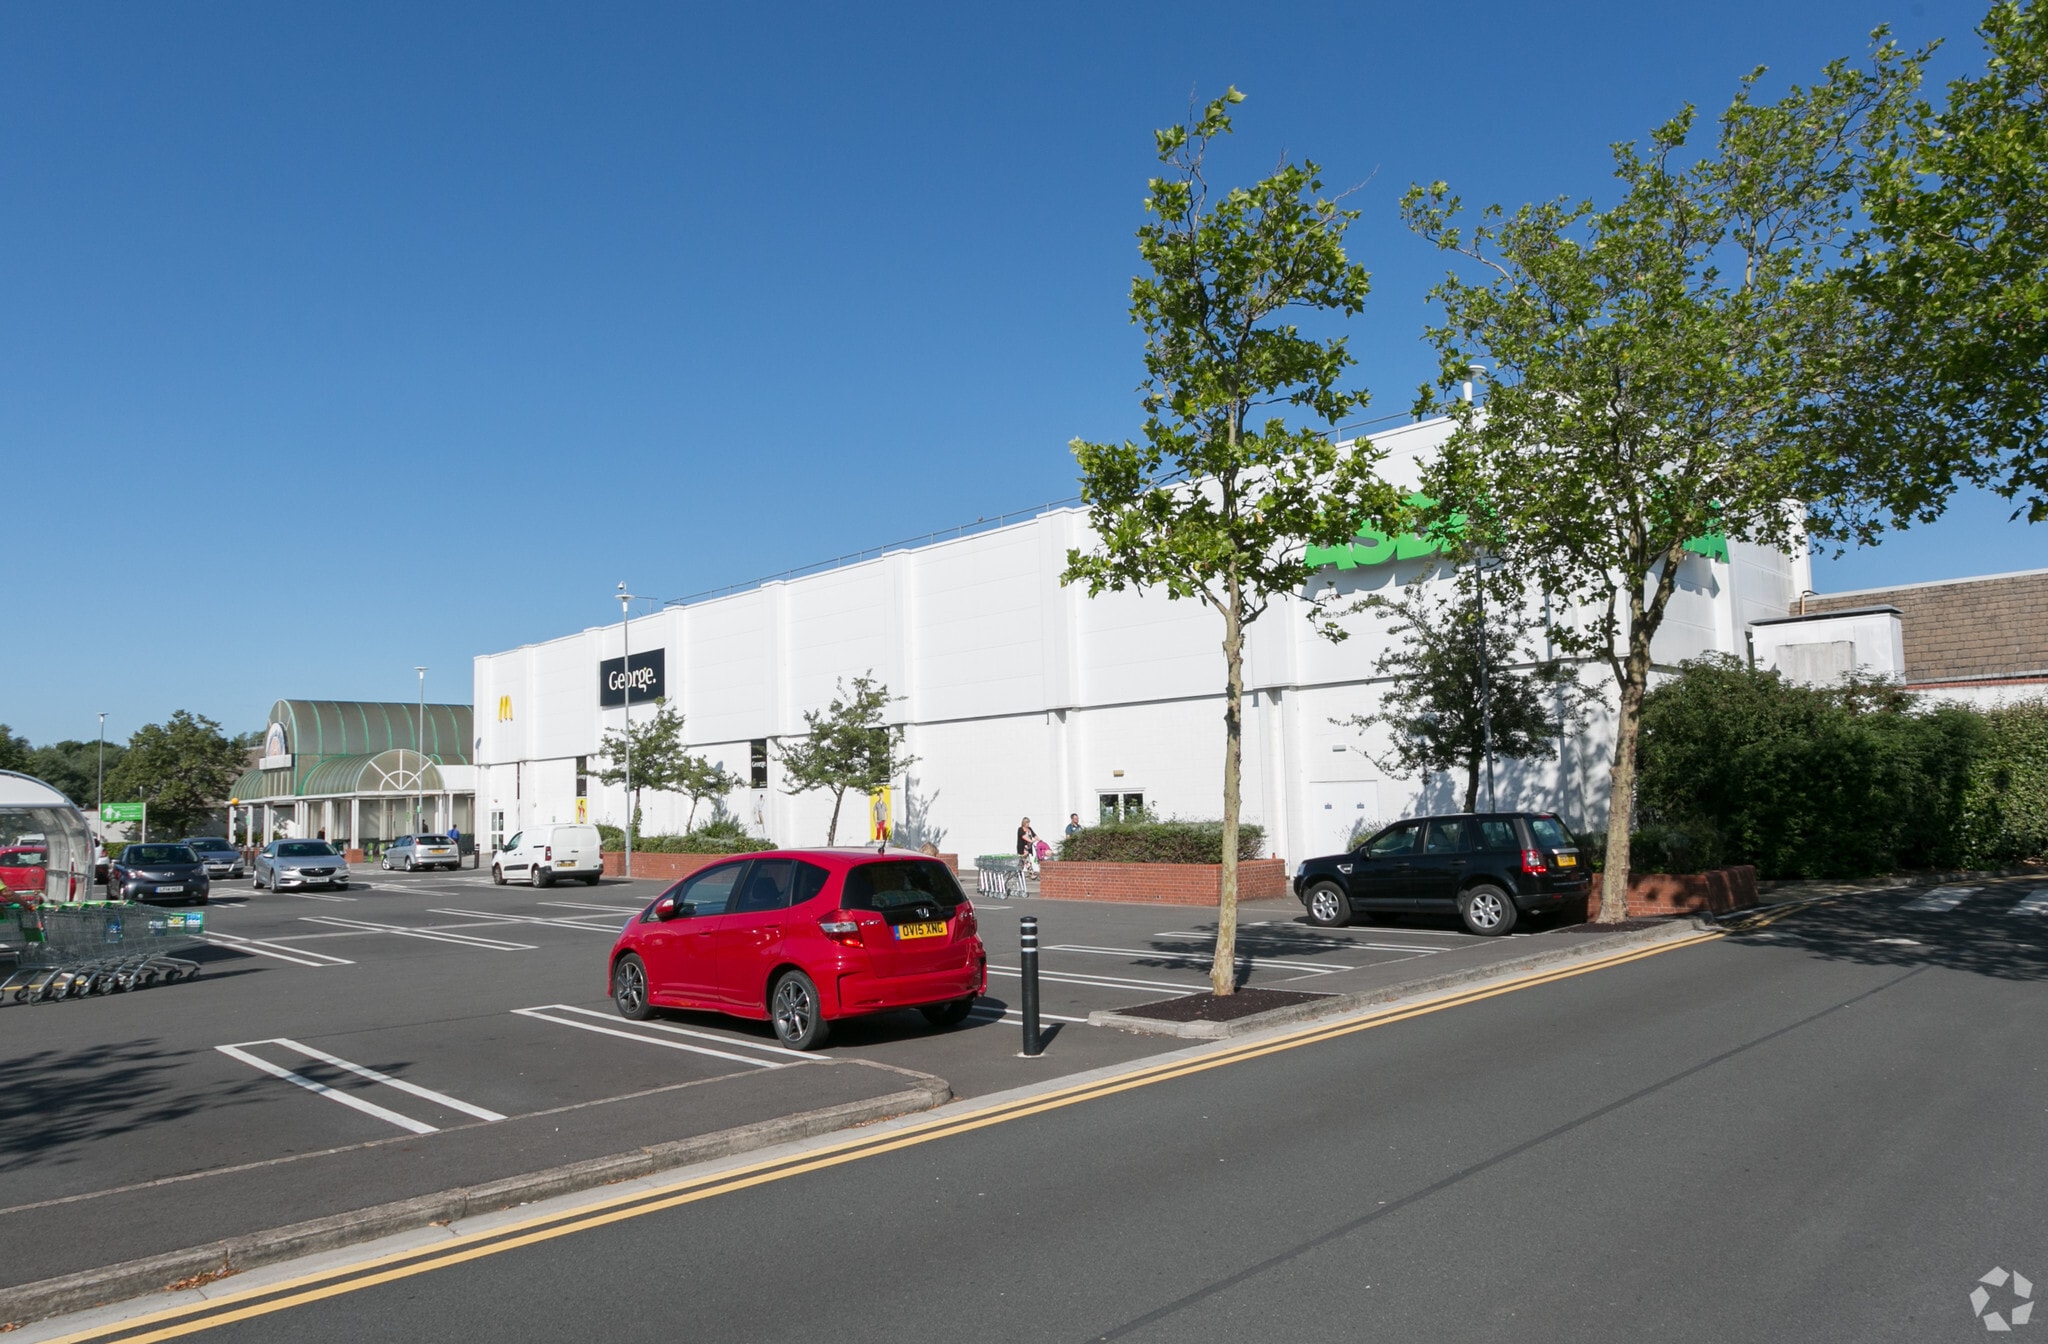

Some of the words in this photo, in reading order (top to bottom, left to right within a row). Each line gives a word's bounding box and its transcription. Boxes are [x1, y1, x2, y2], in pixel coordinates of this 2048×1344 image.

[1305, 491, 1508, 571] SD
[902, 925, 923, 937] OV15
[926, 922, 944, 934] XNG
